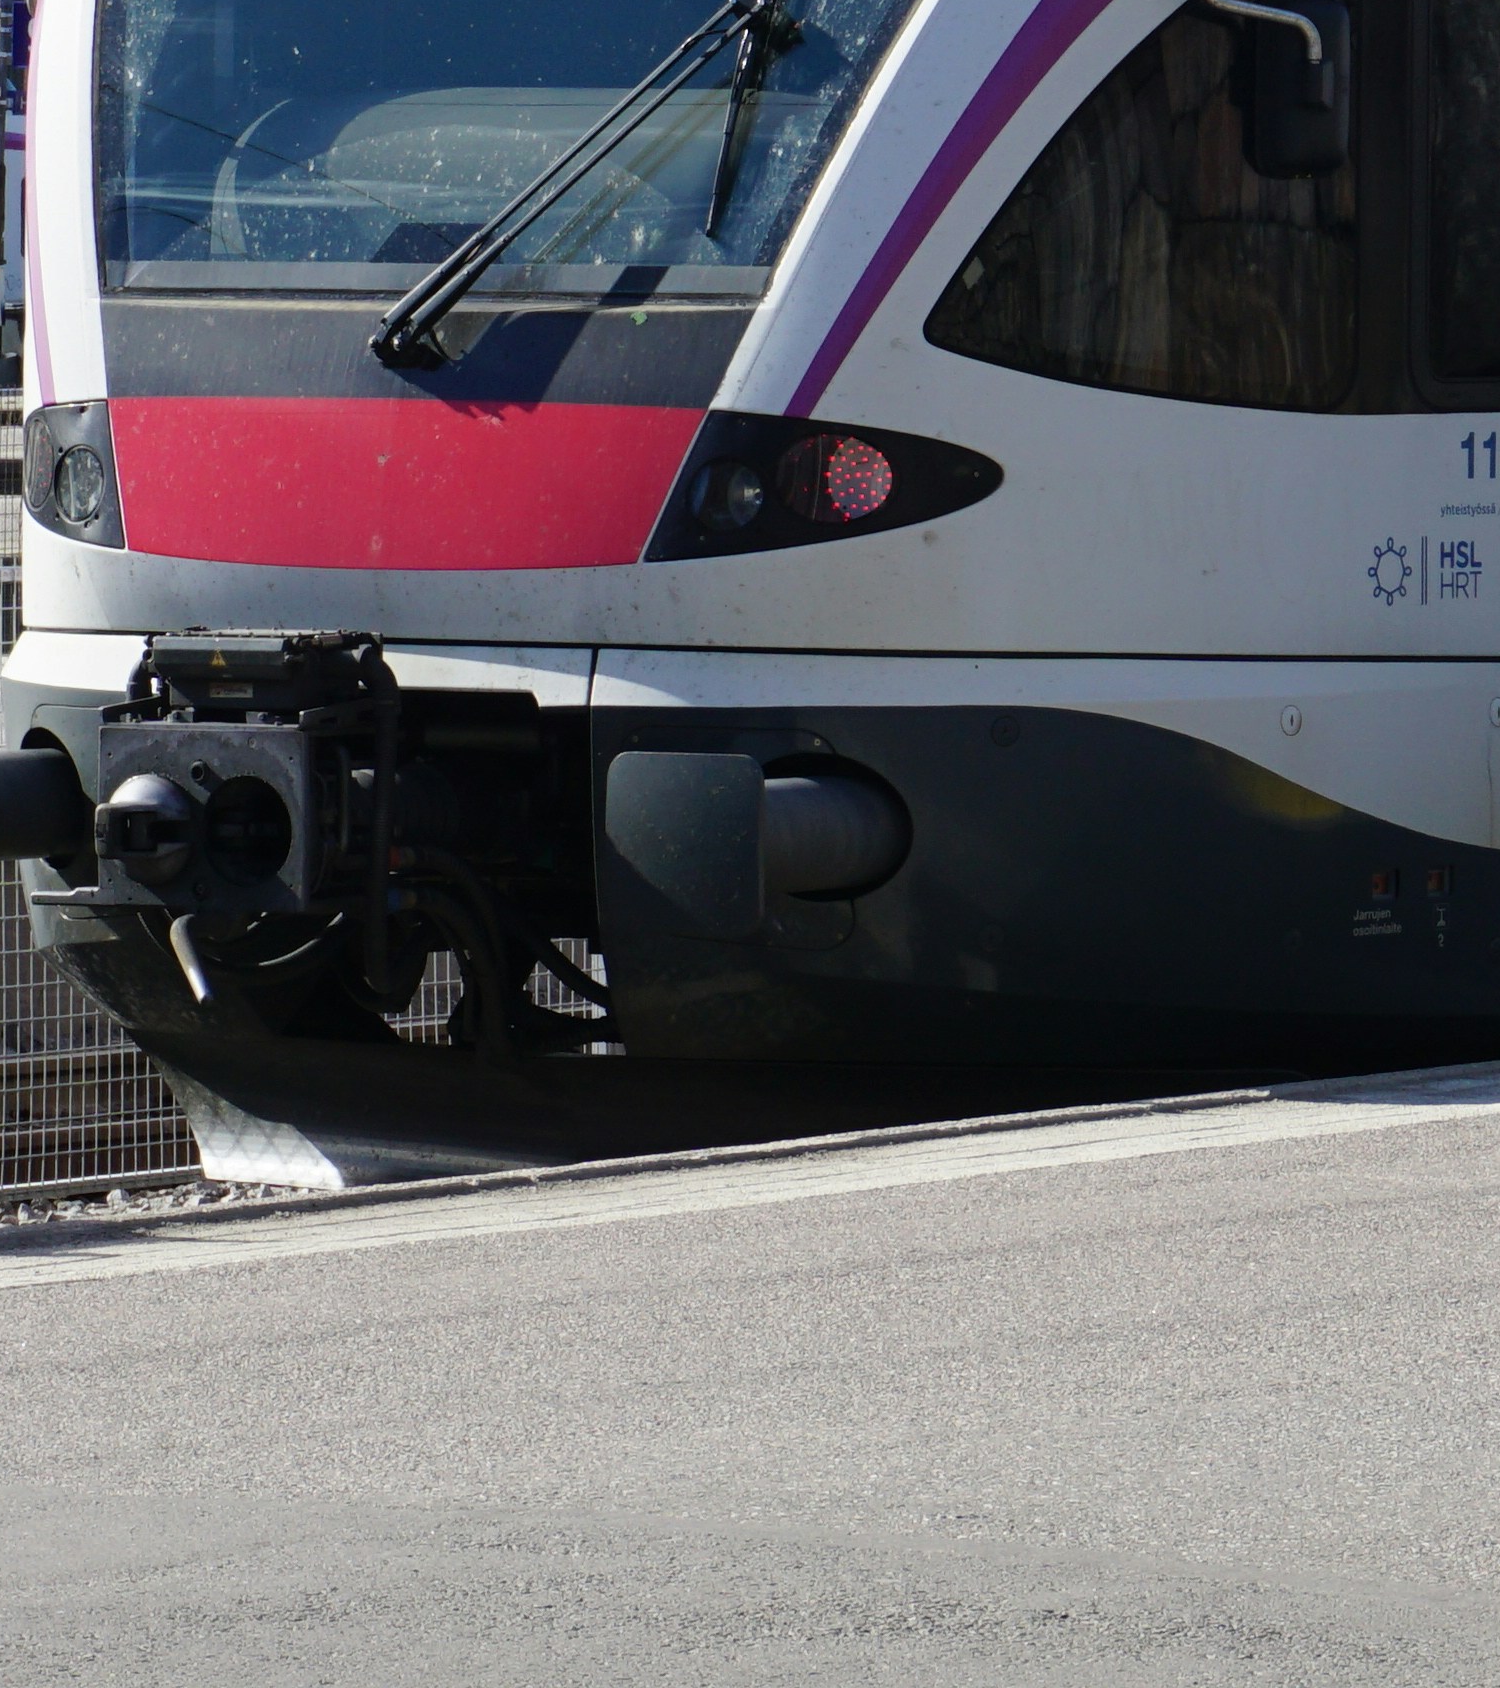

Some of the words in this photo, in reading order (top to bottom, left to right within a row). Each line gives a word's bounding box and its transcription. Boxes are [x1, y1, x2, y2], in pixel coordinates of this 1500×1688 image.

[1461, 431, 1496, 479] 11
[1440, 502, 1496, 518] yhteistyössä
[1440, 541, 1482, 569] HSL
[1440, 570, 1482, 600] HRT
[1353, 908, 1392, 921] Jarrujen
